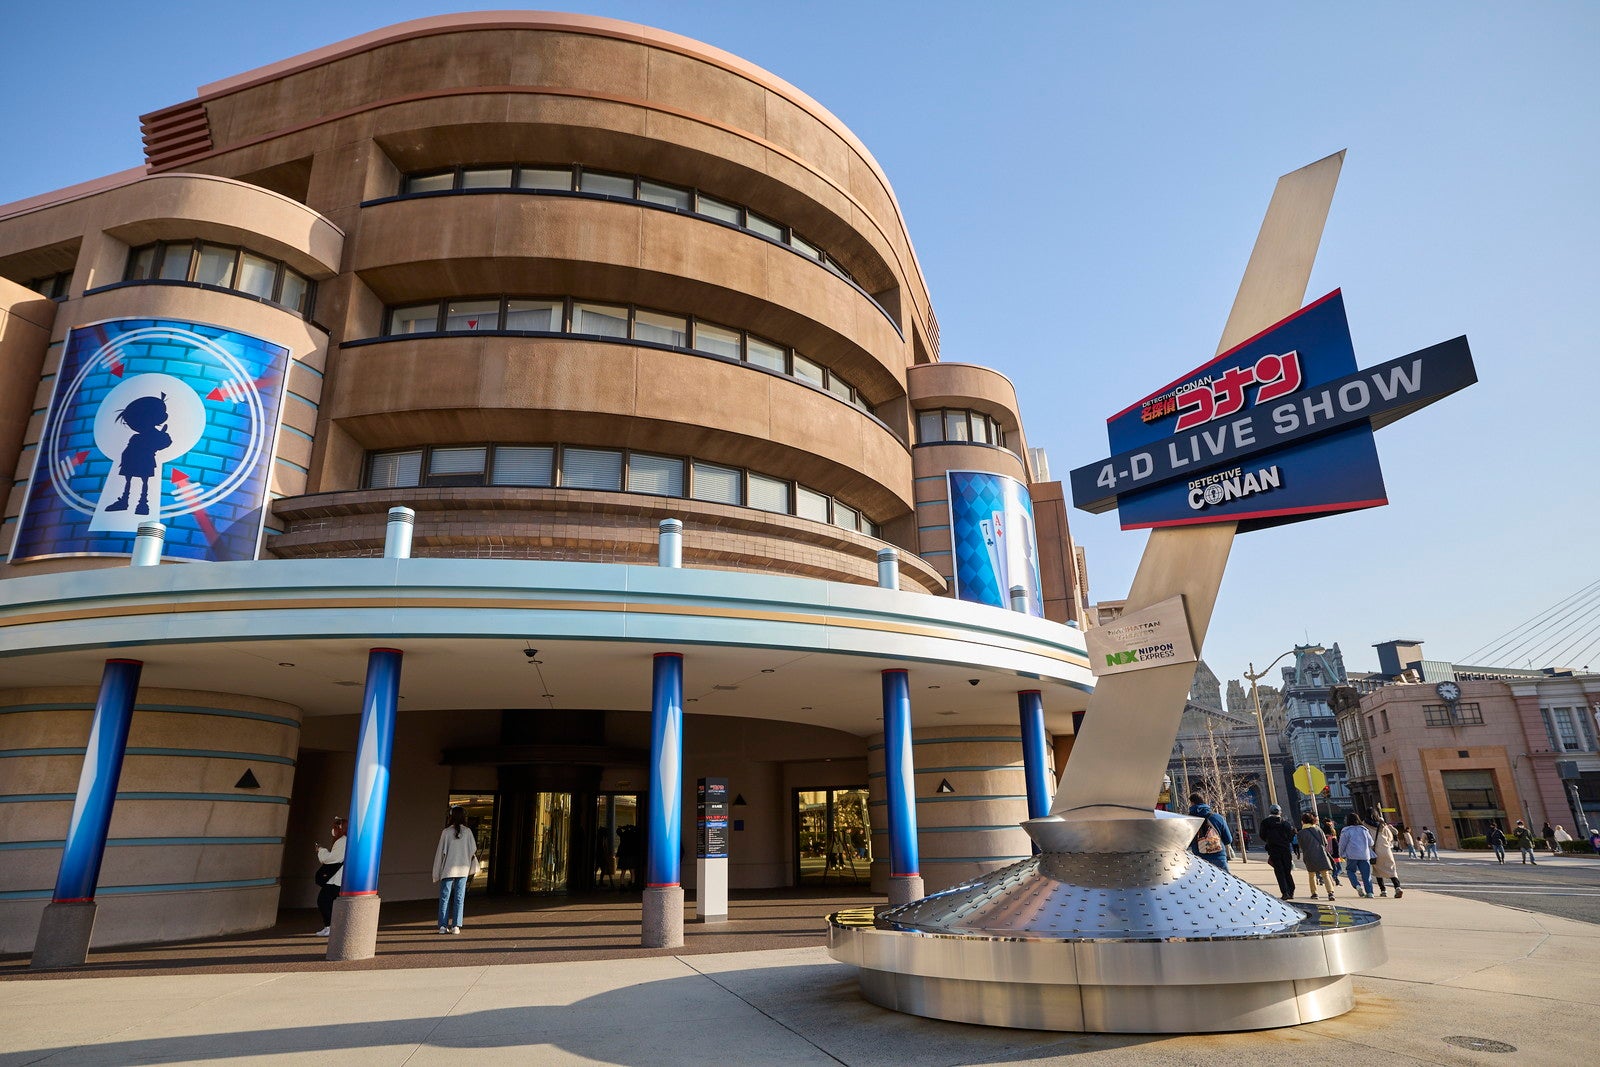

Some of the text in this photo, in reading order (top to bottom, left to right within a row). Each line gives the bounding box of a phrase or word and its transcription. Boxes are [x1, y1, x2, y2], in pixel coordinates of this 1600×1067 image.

[1142, 375, 1212, 407] DETECTIVE CONAN
[1097, 359, 1422, 489] 4-D LIVE SHOW
[1188, 467, 1242, 490] DETECTIVE
[1188, 465, 1280, 510] CONAN
[1138, 643, 1174, 655] NIPPON
[1139, 650, 1175, 662] EXPRESS
